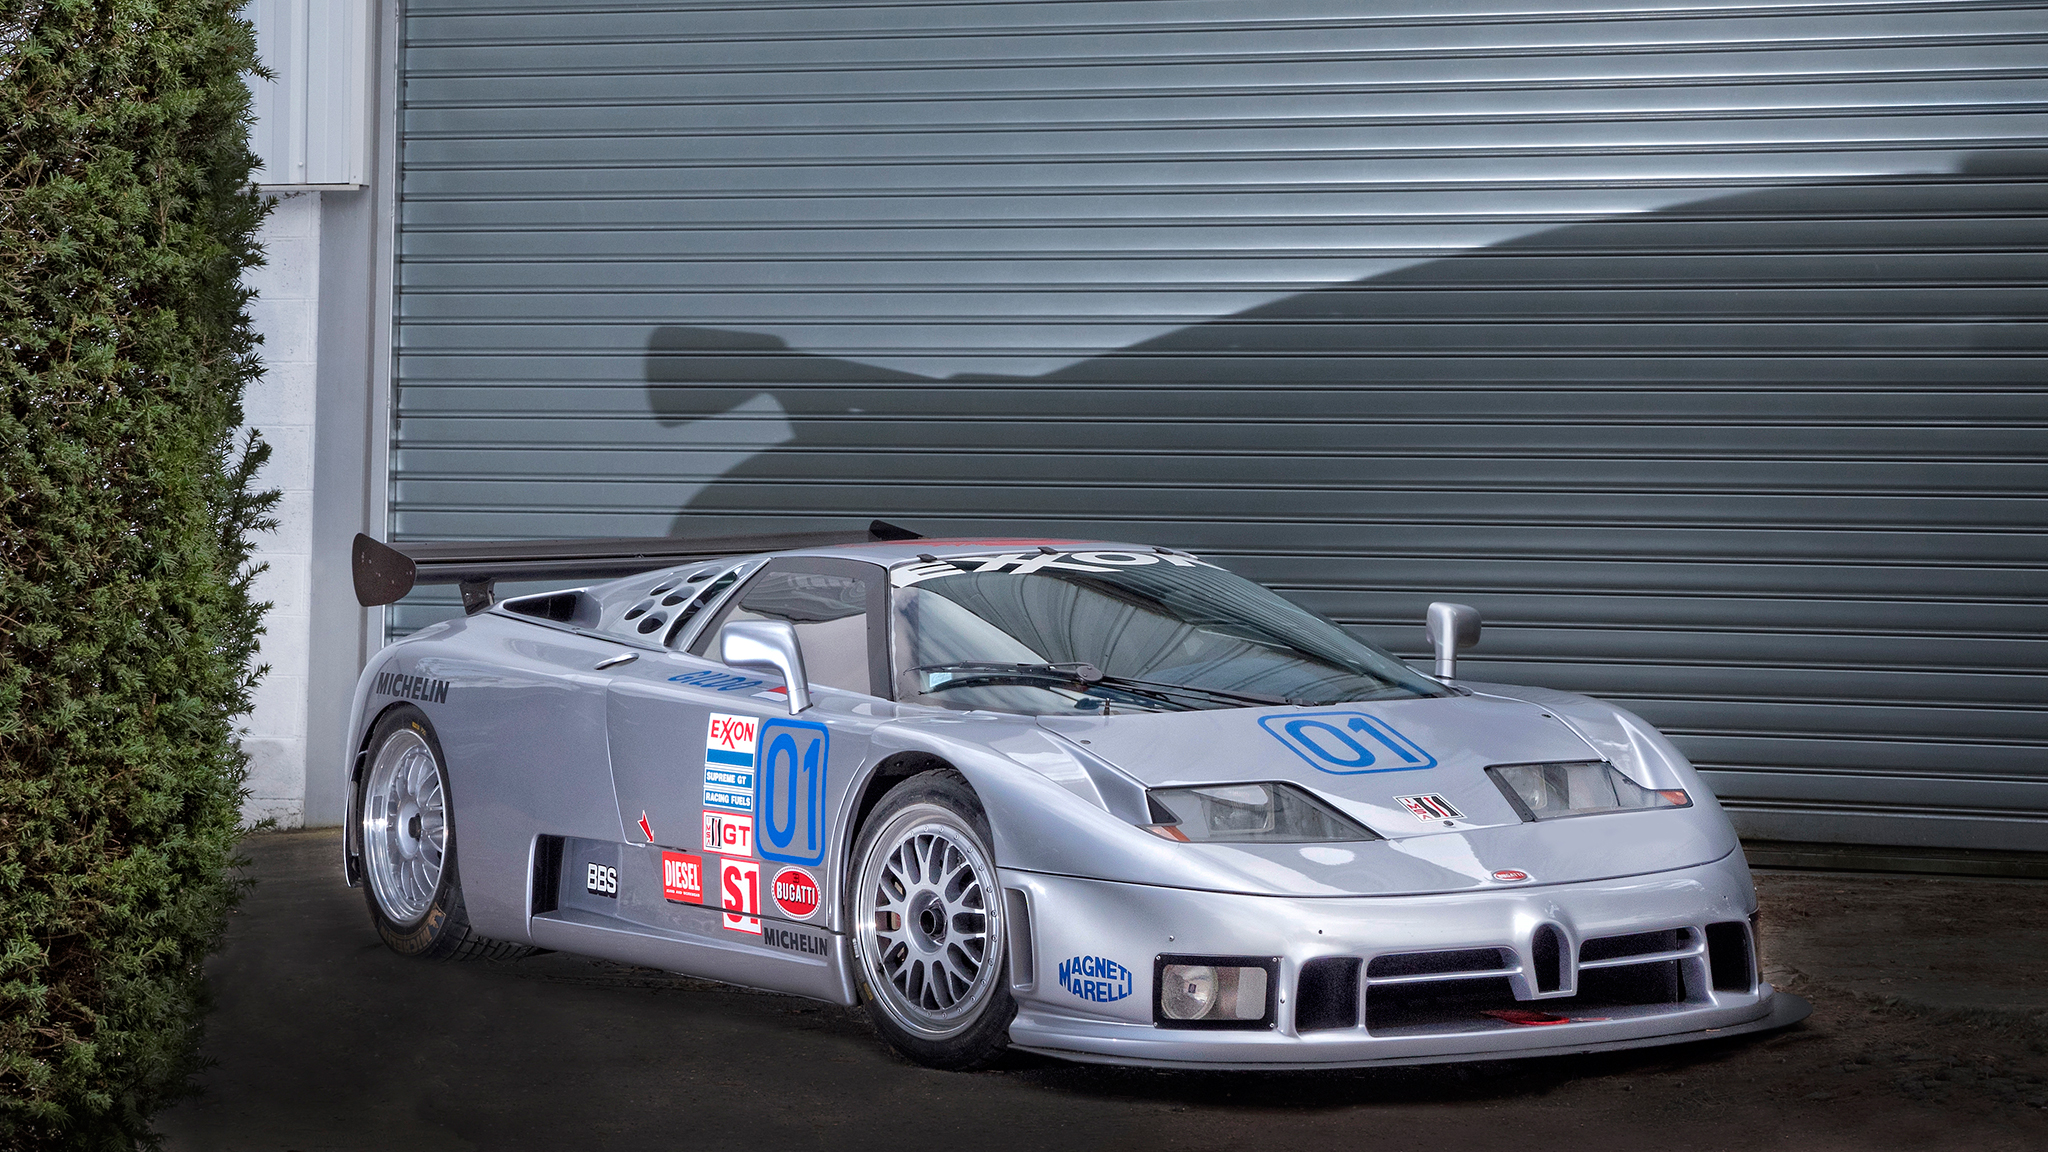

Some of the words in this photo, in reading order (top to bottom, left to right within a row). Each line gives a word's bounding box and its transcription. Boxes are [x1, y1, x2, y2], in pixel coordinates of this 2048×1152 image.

[376, 672, 450, 704] MICHELIN
[710, 717, 754, 749] EXXON
[1284, 717, 1421, 768] 01
[706, 771, 736, 784] SUPREME
[737, 775, 747, 785] GT
[765, 733, 821, 850] 01
[705, 792, 730, 804] RACING
[731, 795, 751, 807] FUELS
[723, 823, 750, 847] GT
[587, 862, 618, 897] BBS
[664, 859, 701, 891] DIESEL
[723, 865, 759, 925] S1
[776, 881, 816, 906] BUGATTI
[763, 927, 828, 956] MICHELIN
[1059, 955, 1132, 985] MAGNETI
[1059, 974, 1132, 1003] MARELLI
